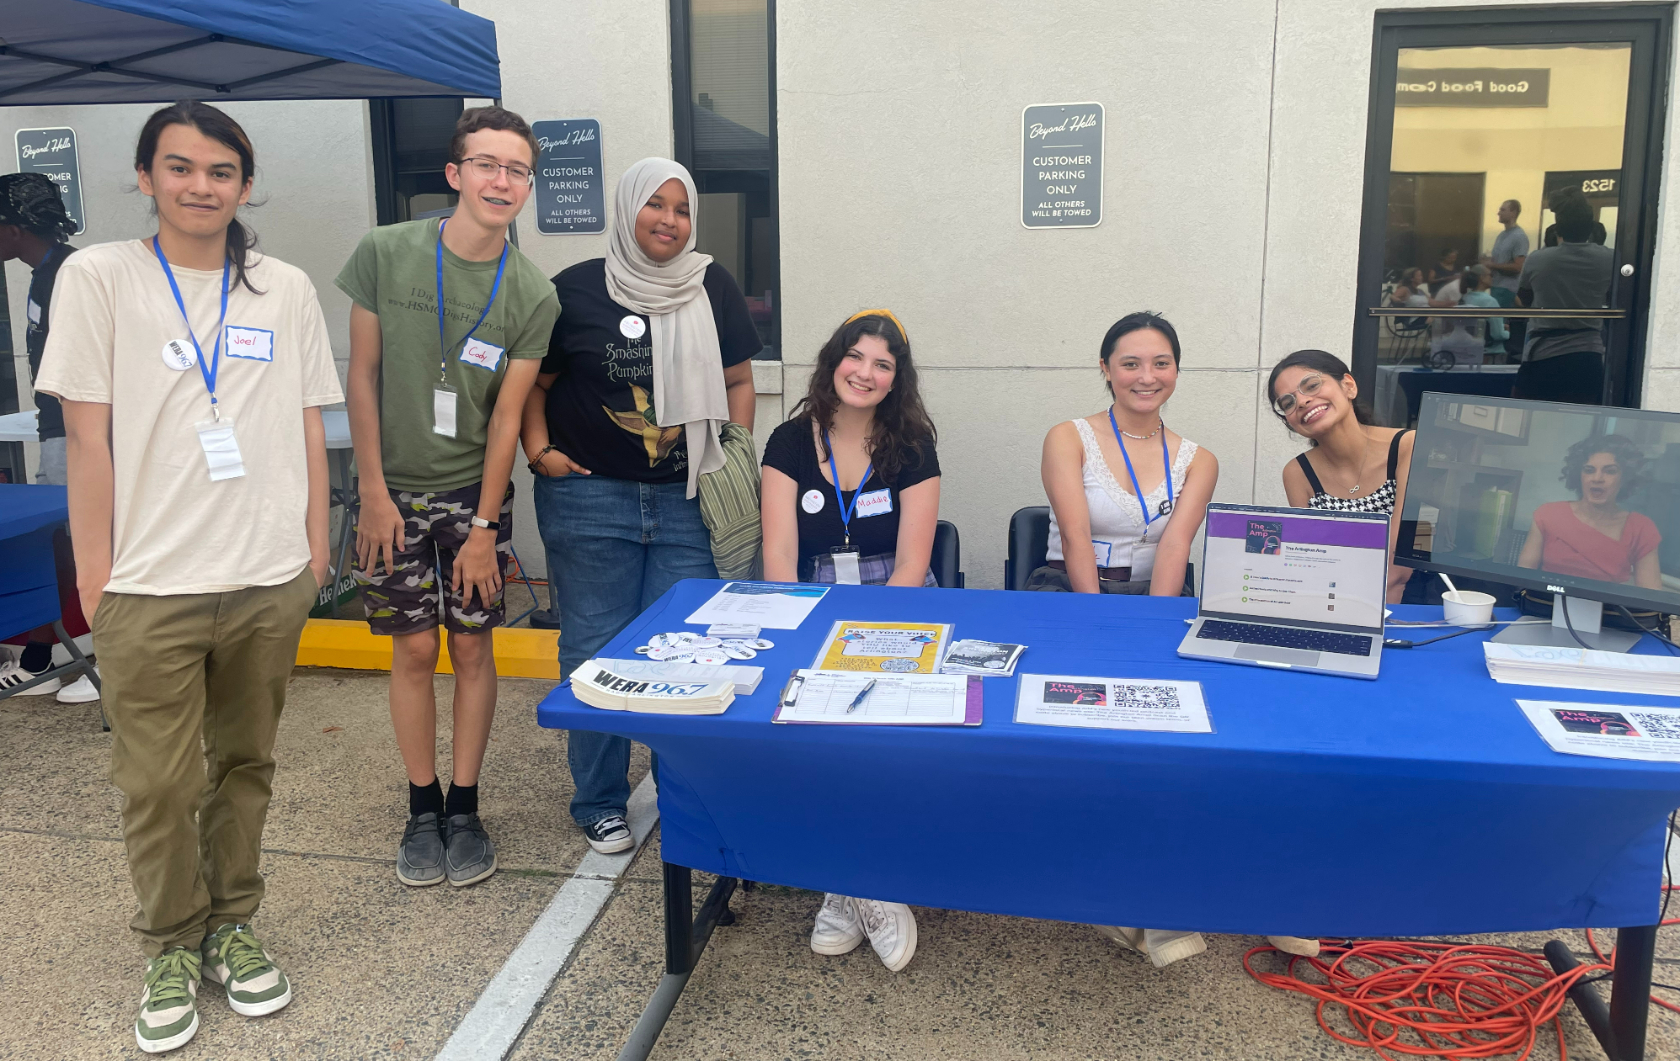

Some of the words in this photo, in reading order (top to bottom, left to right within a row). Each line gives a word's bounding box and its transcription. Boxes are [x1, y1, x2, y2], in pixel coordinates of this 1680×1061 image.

[1030, 118, 1068, 140] Beyond
[1069, 114, 1097, 132] Hello
[538, 132, 570, 152] Beyond
[572, 128, 596, 145] Hello
[22, 140, 50, 159] Beyond
[50, 137, 71, 152] Hello
[1032, 155, 1092, 166] CUSTOMER
[542, 167, 594, 177] CUSTOMER
[1039, 170, 1086, 180] PARKING
[549, 180, 590, 190] PARKING
[1046, 184, 1078, 195] ONLY
[556, 194, 583, 204] ONLY
[1038, 201, 1053, 209] ALL
[1054, 200, 1086, 208] OTHERS
[564, 208, 591, 216] OTHERS
[1064, 208, 1092, 216] TOWED
[573, 216, 597, 224] TOWED
[417, 288, 435, 302] Dig
[234, 335, 257, 346] Joel
[468, 346, 488, 362] Cody
[602, 342, 652, 365] Smashin
[858, 495, 889, 509] Maddie
[1250, 522, 1264, 530] The
[1249, 530, 1268, 538] Amp
[1546, 584, 1566, 593] DELL
[593, 670, 650, 694] WERA
